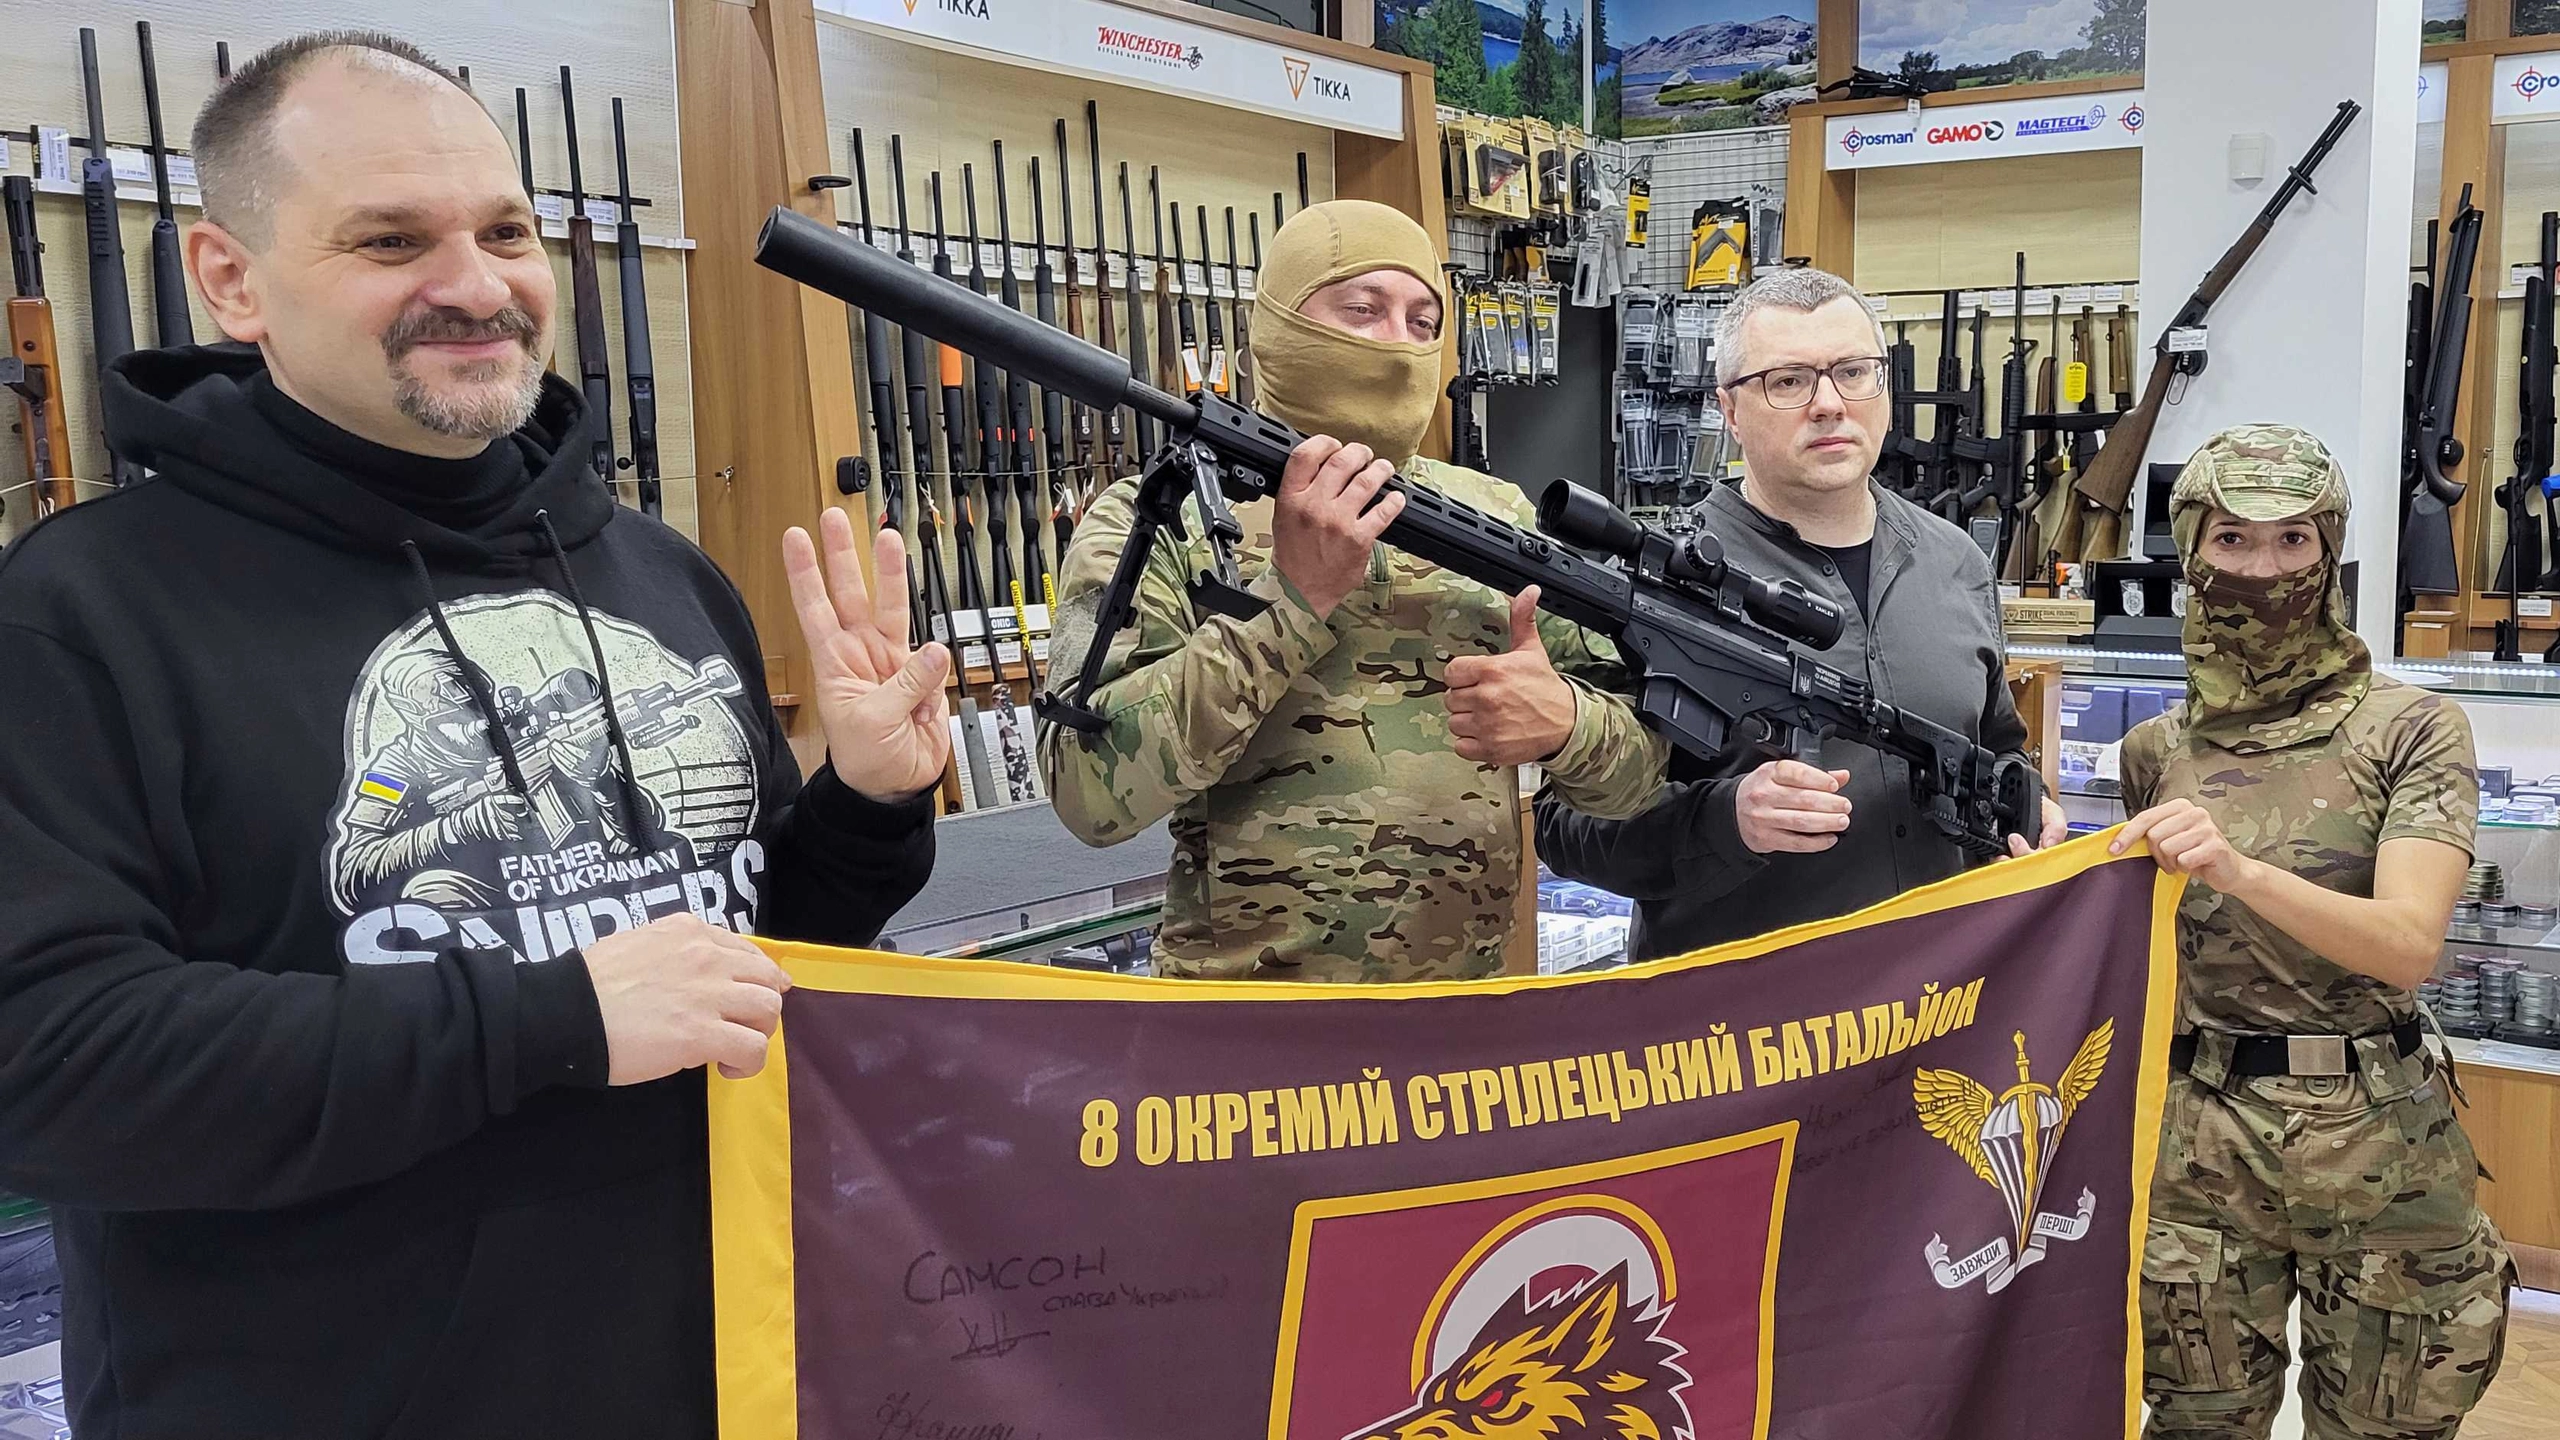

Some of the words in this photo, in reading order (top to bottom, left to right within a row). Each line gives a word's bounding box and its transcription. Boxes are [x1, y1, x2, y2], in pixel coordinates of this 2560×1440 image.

[1098, 26, 1183, 60] WINCHESTER
[1313, 76, 1351, 102] TIKKA
[1926, 123, 1982, 145] GAMO
[2017, 115, 2087, 131] MAGTECH
[2019, 609, 2043, 620] STRIKE
[499, 841, 606, 881] FATHER
[507, 877, 543, 902] OF
[1079, 1098, 1120, 1168] 8
[1134, 1066, 1400, 1167] ОКРЕМИЙ
[1406, 1023, 1744, 1141] СТРІЛЕЦЬКИЙ
[1747, 976, 1986, 1088] БАТАЛЬЙОН
[2039, 1214, 2076, 1235] ПЕРШІ
[904, 1246, 1107, 1304] САМСОН
[1950, 1242, 2002, 1282] ЗАВЖДИ
